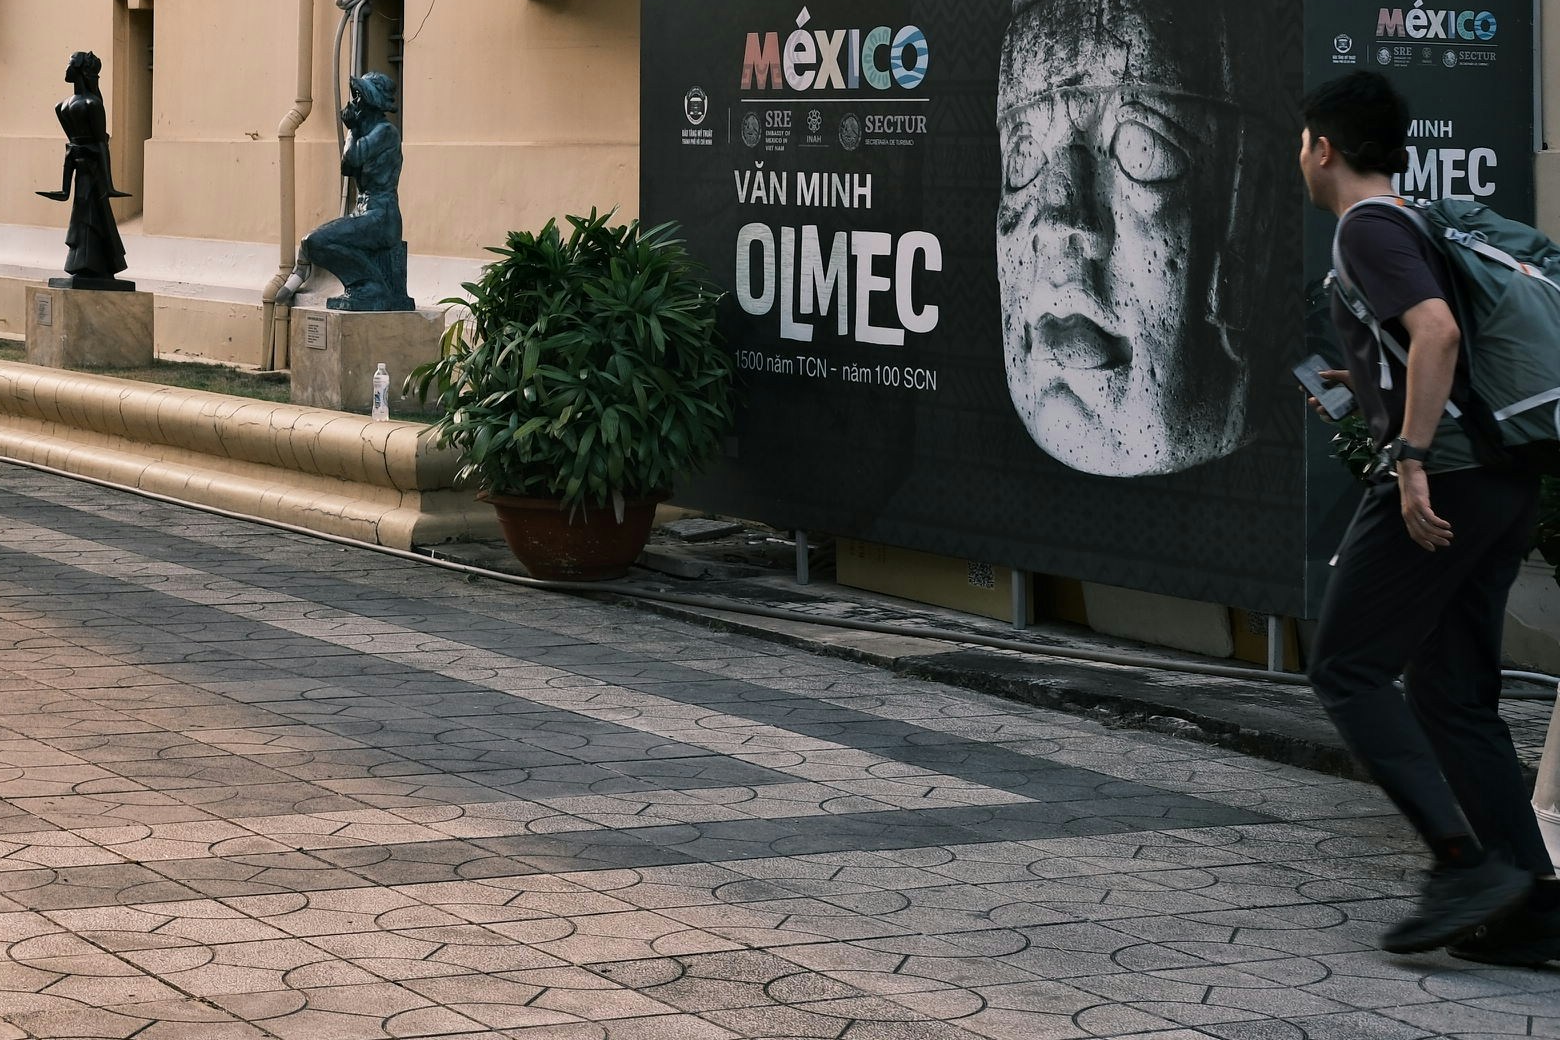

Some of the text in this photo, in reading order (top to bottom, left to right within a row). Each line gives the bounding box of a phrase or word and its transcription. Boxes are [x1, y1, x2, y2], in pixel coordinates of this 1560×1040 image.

[765, 110, 792, 128] SRE
[865, 115, 927, 134] SECTUR
[734, 160, 872, 209] VĂN MINH
[736, 222, 943, 346] OLMEC
[736, 349, 764, 371] 1500
[767, 352, 794, 375] năm
[796, 357, 827, 378] TCN
[843, 362, 872, 384] năm
[874, 364, 900, 387] 100
[903, 367, 937, 391] SCN
